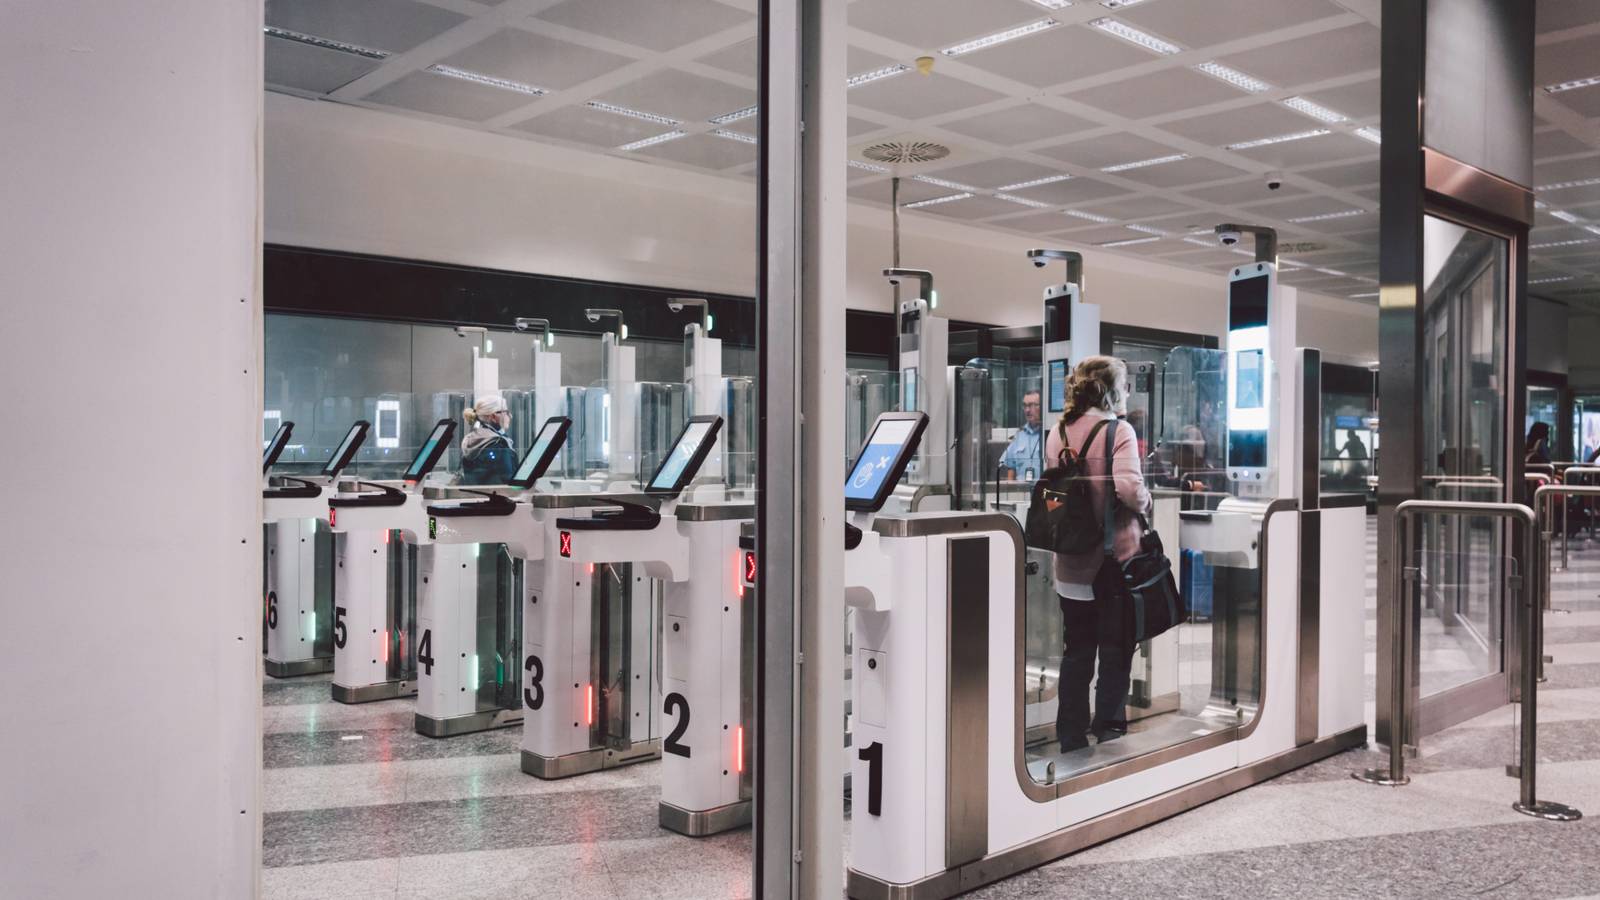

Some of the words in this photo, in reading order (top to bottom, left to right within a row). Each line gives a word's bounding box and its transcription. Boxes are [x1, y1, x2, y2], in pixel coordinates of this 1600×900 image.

[267, 590, 278, 630] 6
[334, 606, 348, 650] 5
[417, 629, 435, 677] 4
[523, 655, 545, 711] 3
[663, 693, 691, 759] 2
[858, 742, 883, 818] 1
